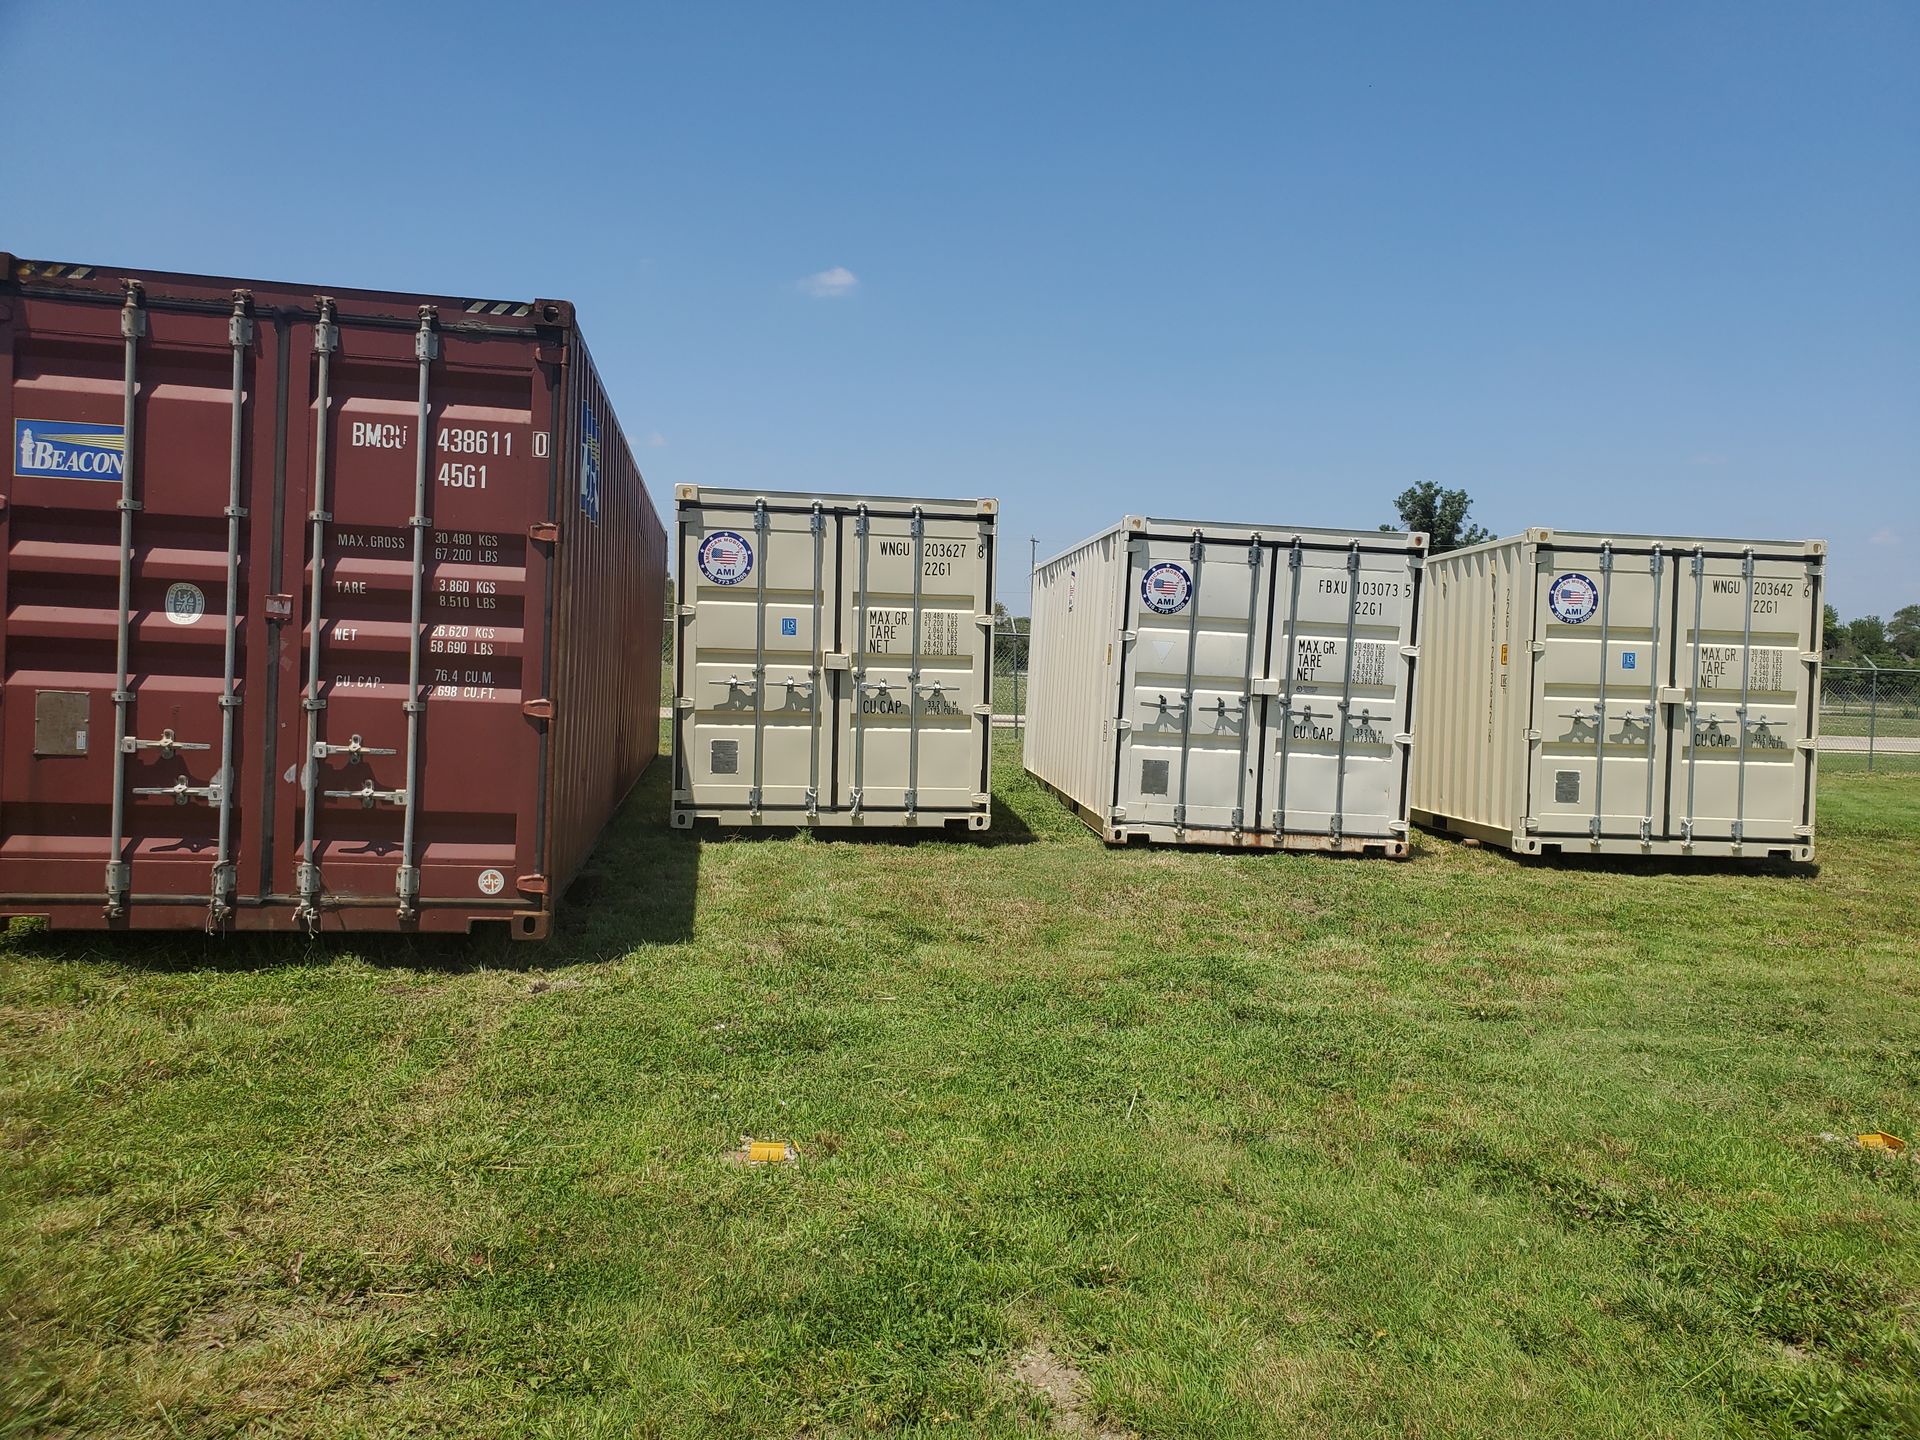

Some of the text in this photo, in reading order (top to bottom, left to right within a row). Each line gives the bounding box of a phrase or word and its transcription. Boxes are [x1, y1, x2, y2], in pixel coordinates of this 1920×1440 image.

[437, 428, 512, 456] 438611
[534, 432, 548, 457] 0
[33, 441, 124, 474] BEACON
[438, 462, 487, 489] 45G1
[435, 532, 472, 546] 30.480
[478, 534, 498, 547] KGS
[435, 548, 498, 563] 67.200 LBS
[879, 541, 985, 559] WNGU 203627 8
[715, 568, 735, 576] AMI
[924, 562, 951, 577] 22G1
[335, 579, 496, 595] TARE 3.860 KGS
[1318, 579, 1411, 598] FBXU 103073 5
[1712, 580, 1810, 598] WNGU 203642 6
[439, 595, 496, 610] 8.510 LBS
[1354, 601, 1382, 616] 22G1
[1753, 600, 1778, 614] 22G1
[334, 625, 495, 641] NET 26.620 KGS
[870, 625, 897, 640] TARE
[430, 640, 494, 656] 58.690 LBS
[869, 639, 890, 654] NET
[1298, 654, 1322, 668] TARE
[1701, 661, 1726, 675] TARE
[435, 668, 458, 683] 76.4
[465, 670, 495, 684] CU.M.
[1296, 667, 1315, 682] NET
[1700, 674, 1719, 689] NET
[426, 684, 496, 700] 2.698 CU.FT.
